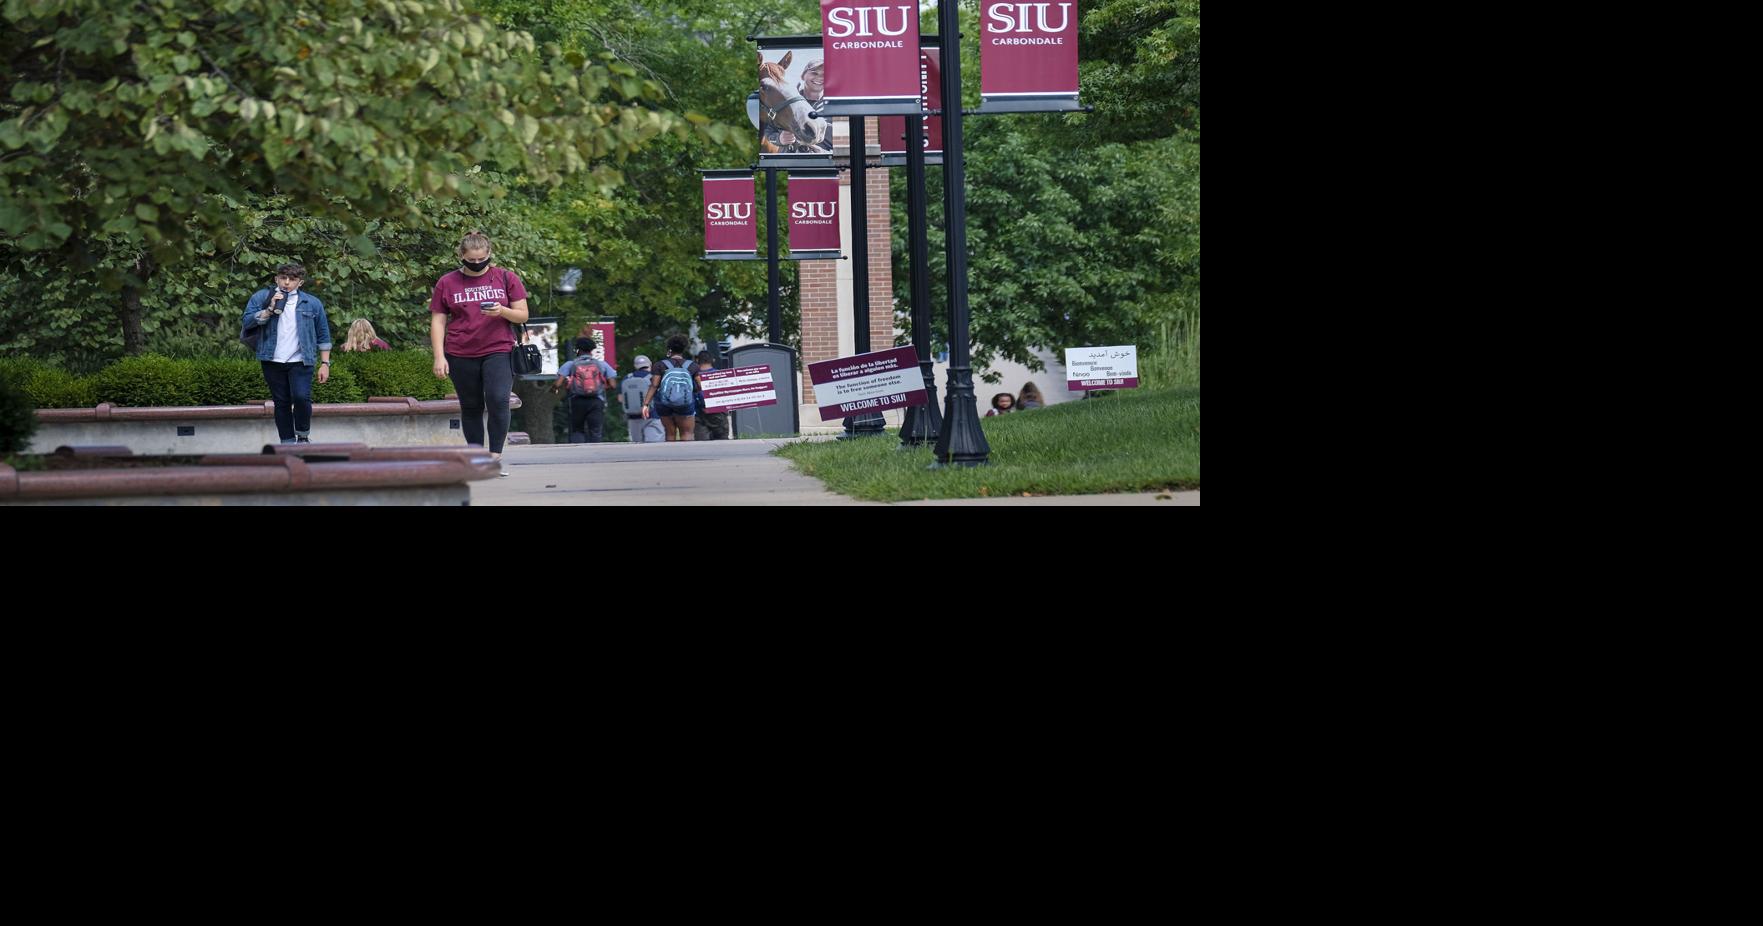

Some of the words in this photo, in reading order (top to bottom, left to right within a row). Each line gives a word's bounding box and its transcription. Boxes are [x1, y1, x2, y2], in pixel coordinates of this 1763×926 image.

[827, 5, 912, 37] SIU
[987, 2, 1072, 33] SIU
[832, 40, 904, 49] CARBONDALE
[991, 37, 1063, 45] CARBONDALE
[707, 202, 752, 219] SIU
[791, 201, 837, 218] SIU
[454, 289, 505, 303] ILLINOIS
[875, 358, 898, 366] libertad
[840, 399, 879, 412] WELCOME
[880, 396, 890, 405] TO
[890, 393, 907, 404] SIU!
